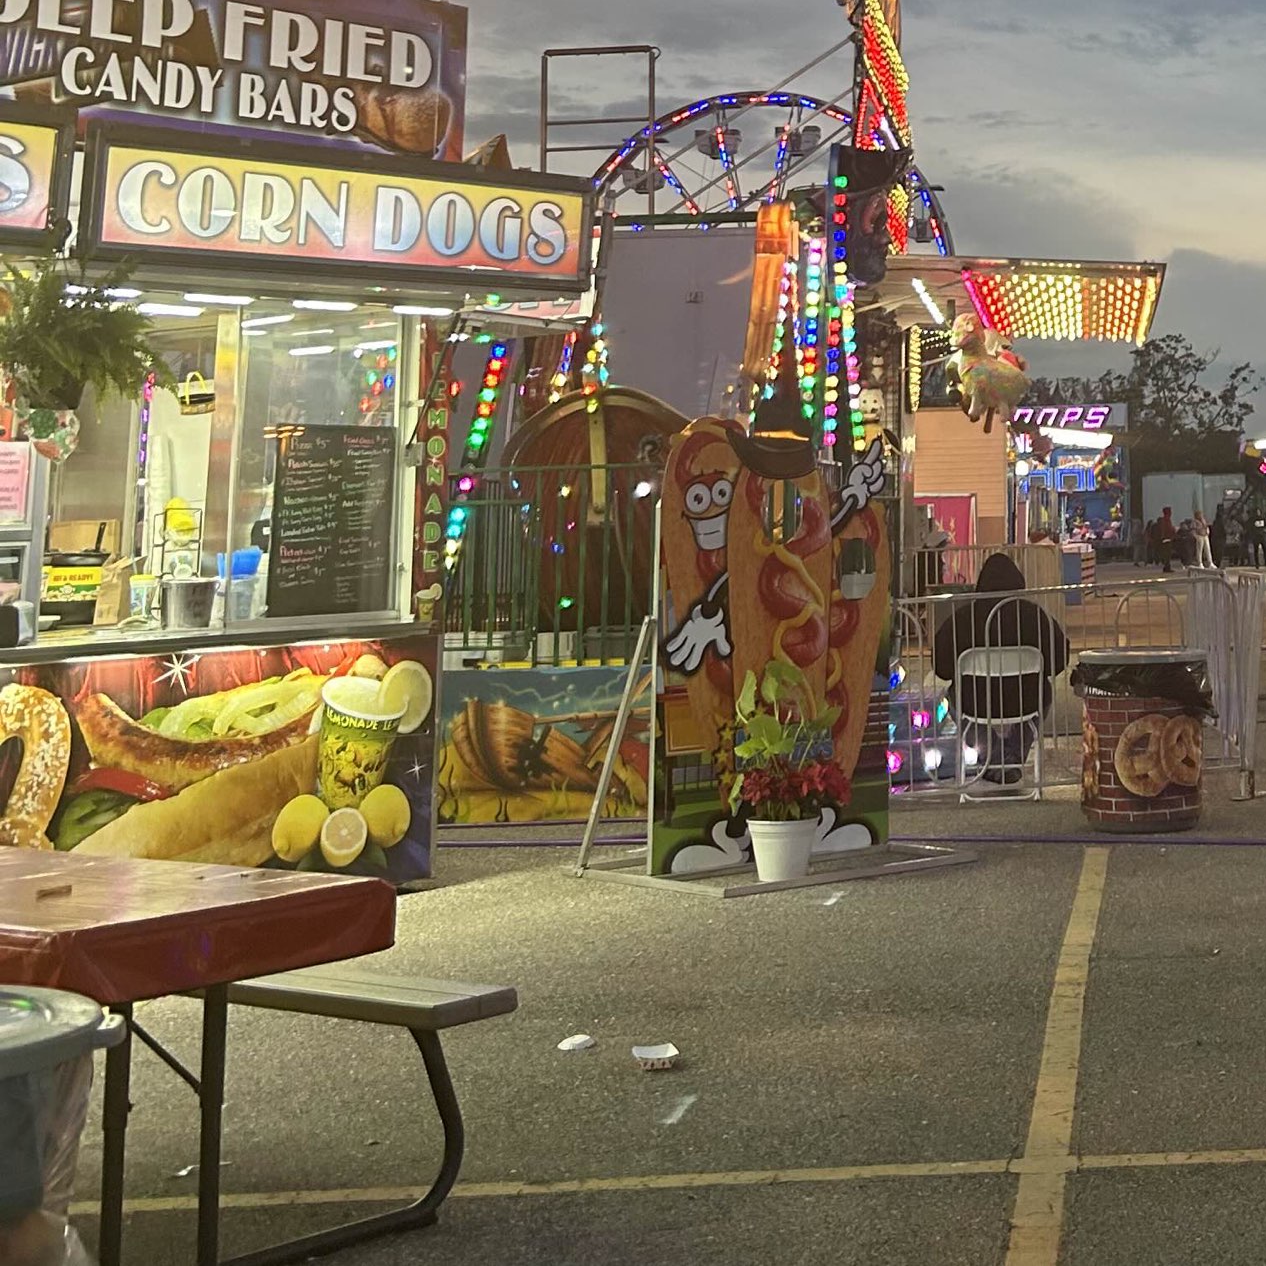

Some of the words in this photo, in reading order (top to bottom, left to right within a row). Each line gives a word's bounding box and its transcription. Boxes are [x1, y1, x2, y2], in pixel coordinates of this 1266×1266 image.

[61, 46, 223, 113] CANDY
[239, 72, 357, 132] BARS
[223, 0, 433, 89] FRIED
[117, 160, 348, 248] CORN
[373, 185, 567, 266] DOGS
[422, 351, 448, 572] LEMONADE
[326, 705, 378, 730] LEMONADE
